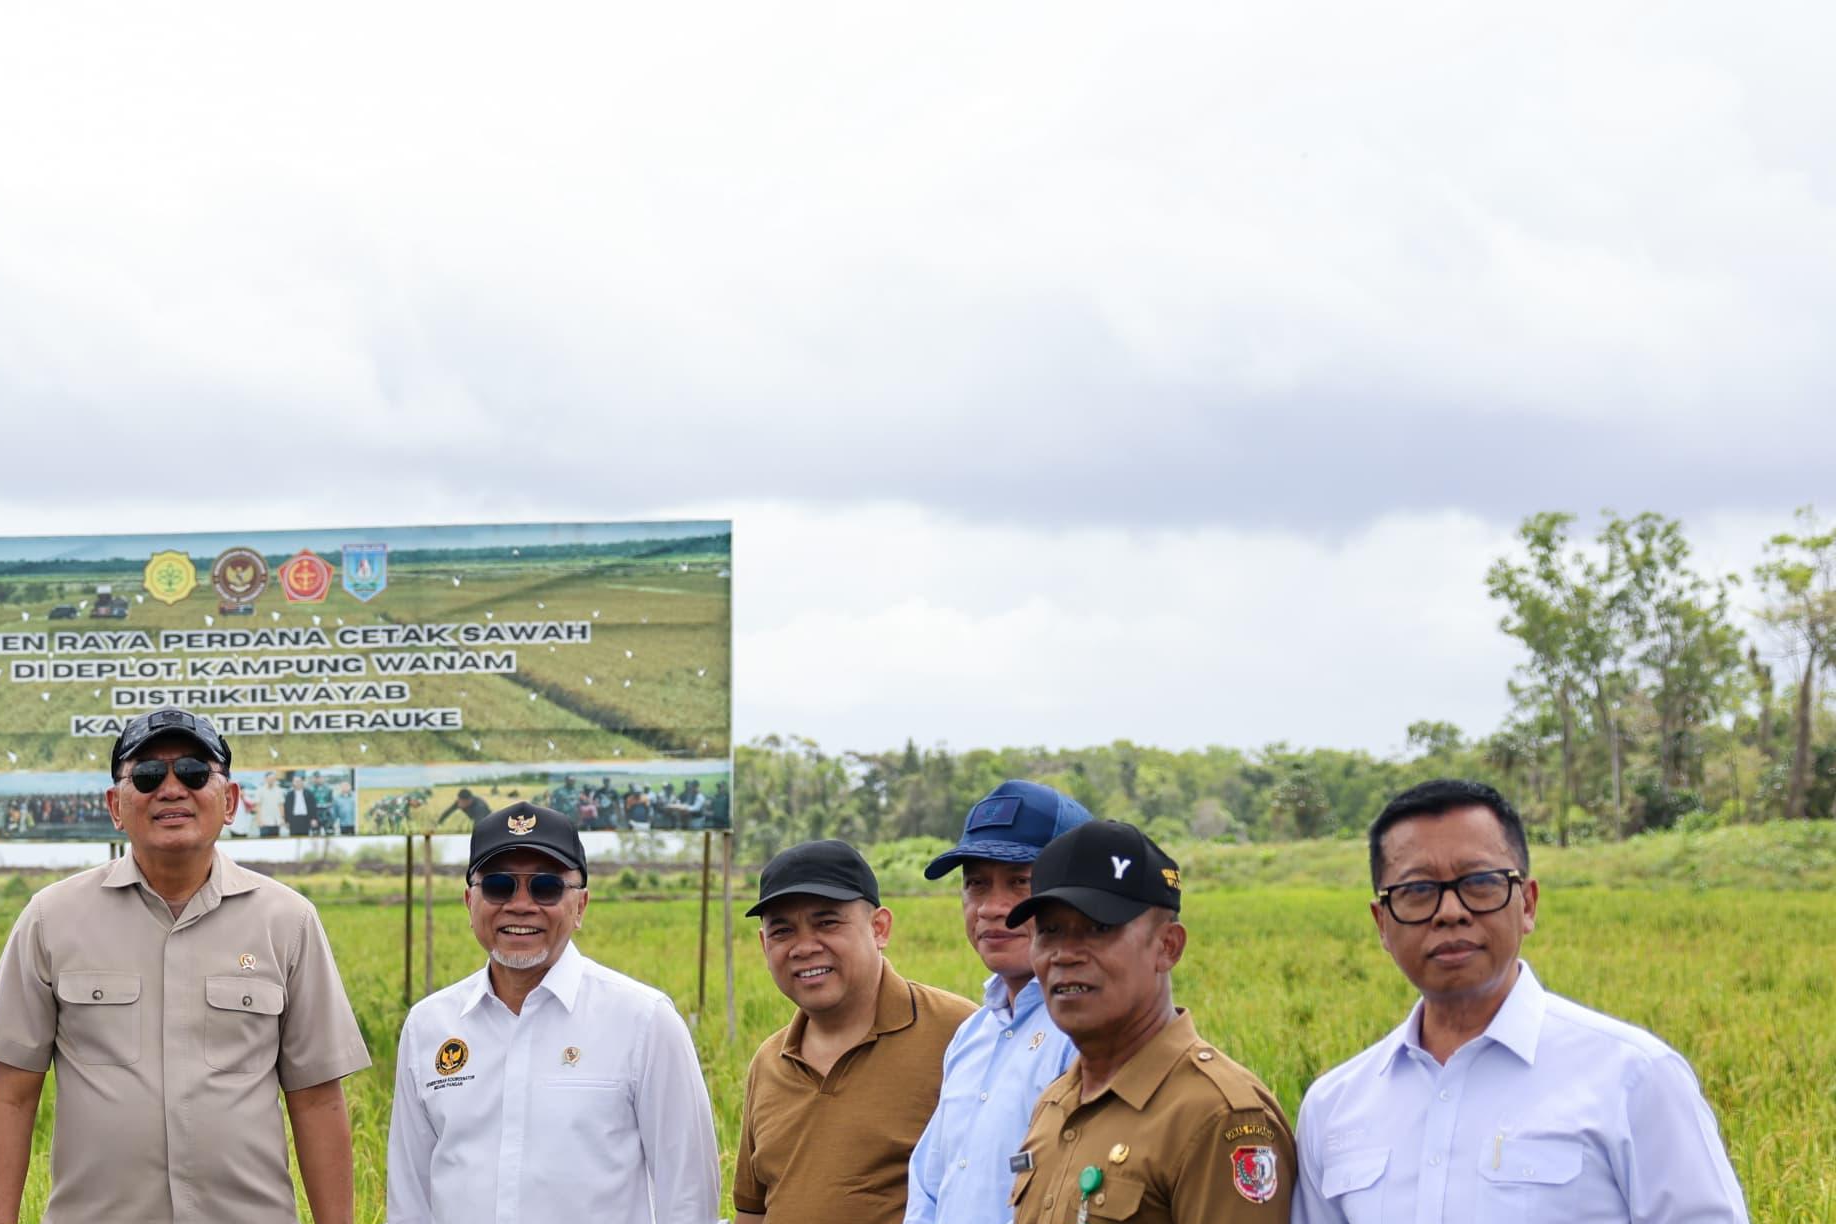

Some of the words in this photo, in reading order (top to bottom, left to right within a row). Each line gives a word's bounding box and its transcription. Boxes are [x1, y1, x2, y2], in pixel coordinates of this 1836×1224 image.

[56, 632, 151, 650] RAYA
[162, 629, 327, 650] PERDANA
[337, 625, 452, 645] CETAK
[462, 623, 590, 643] SAWAH
[13, 662, 46, 679] DI
[189, 656, 364, 677] KAMPUNG
[374, 653, 514, 672] WANAM
[113, 687, 243, 706] DISTRIK
[249, 683, 409, 703] ILWAYAB
[73, 715, 281, 735] KATEN
[292, 709, 460, 731] MERAUKE
[1110, 855, 1132, 880] Y
